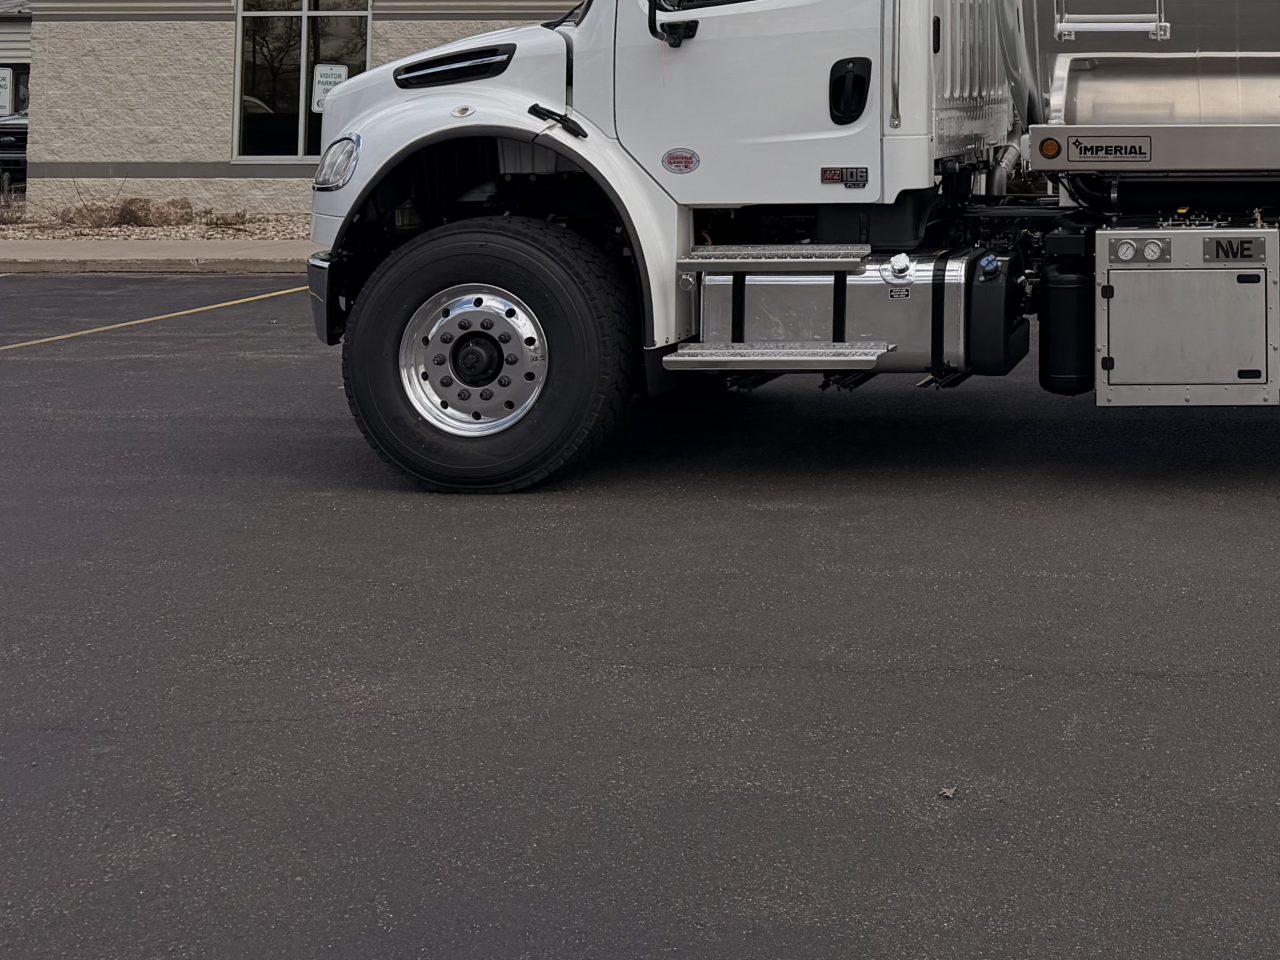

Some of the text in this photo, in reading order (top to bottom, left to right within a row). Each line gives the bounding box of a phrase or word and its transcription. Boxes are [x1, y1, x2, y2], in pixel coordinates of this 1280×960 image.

[1079, 145, 1147, 155] IMPERIAL
[823, 169, 867, 182] M2 106
[1215, 240, 1253, 259] NVE
